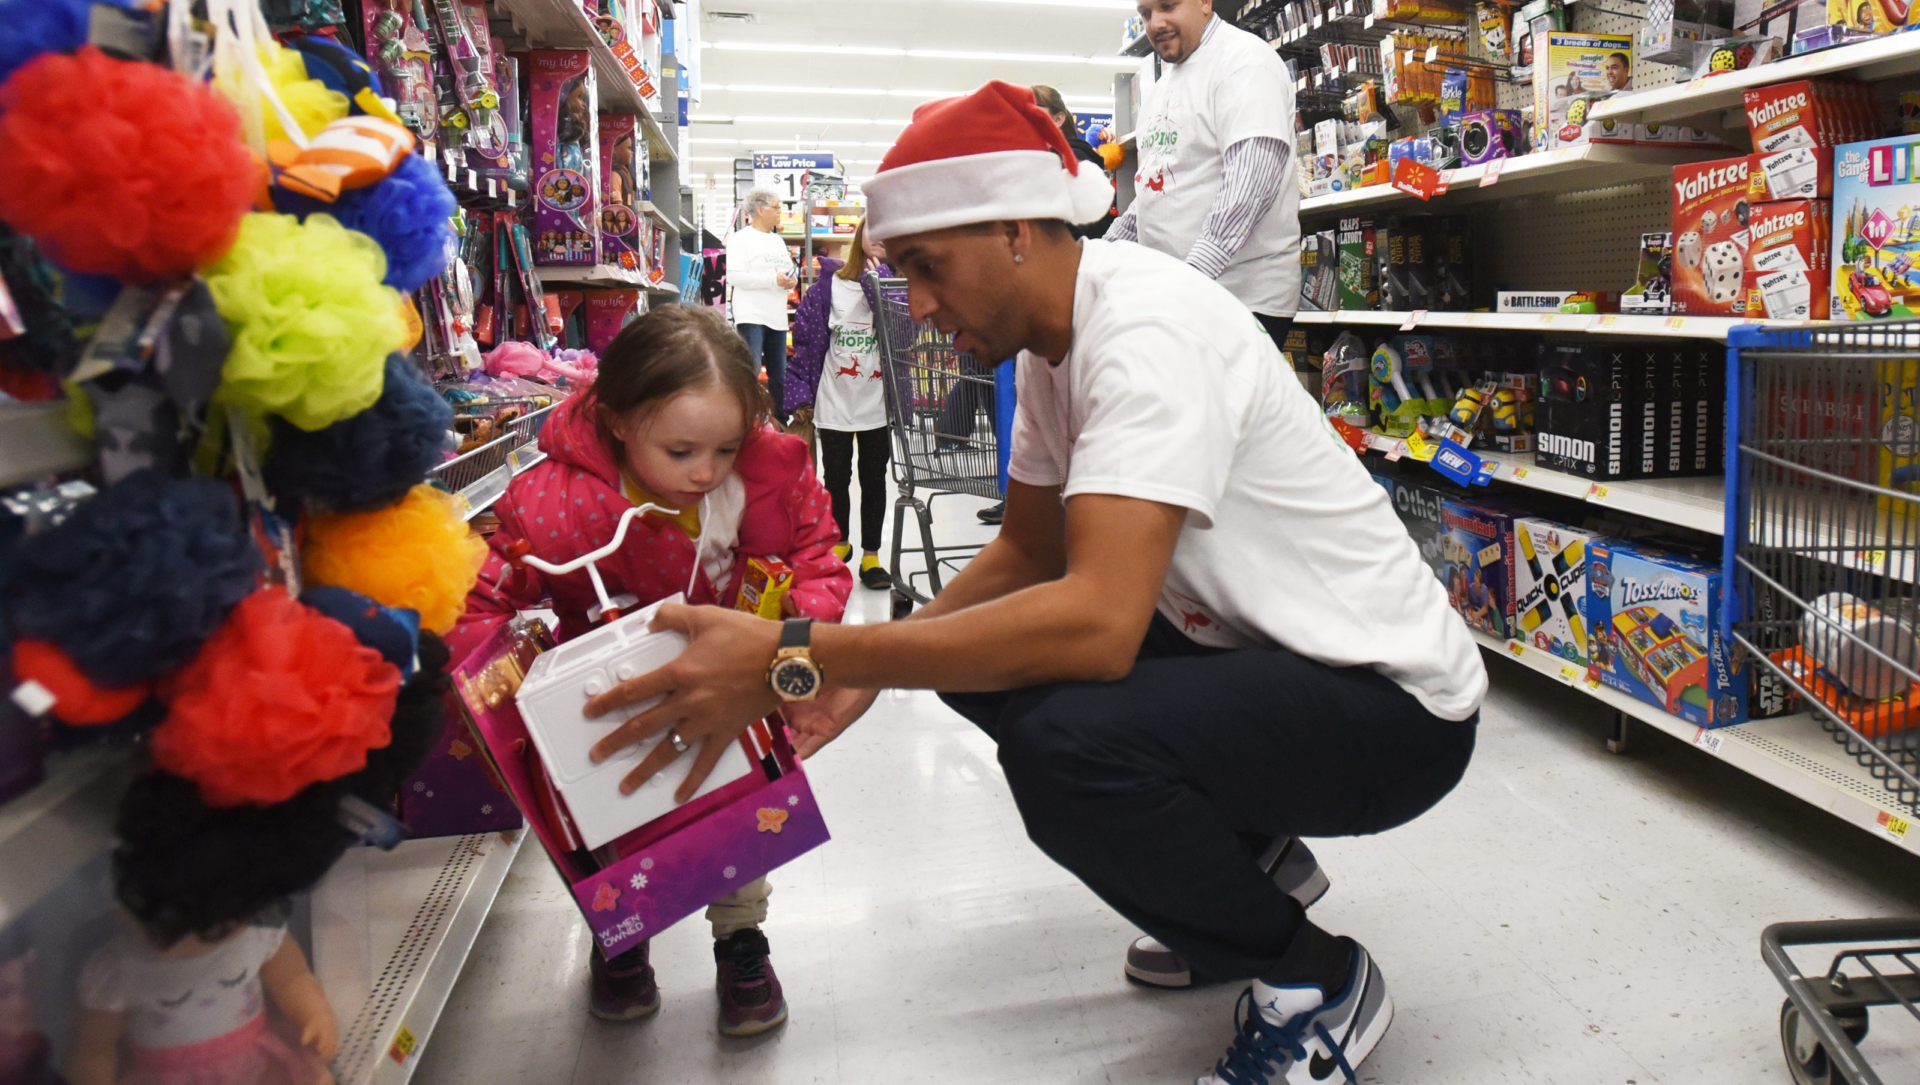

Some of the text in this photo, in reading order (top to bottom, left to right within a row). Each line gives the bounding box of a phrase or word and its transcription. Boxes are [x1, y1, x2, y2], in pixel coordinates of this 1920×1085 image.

[539, 55, 580, 68] my life
[1441, 82, 1463, 99] Farkle
[1747, 92, 1807, 128] Yahtzee
[1765, 133, 1790, 151] Yahtzee
[771, 158, 816, 168] Low Price
[1766, 153, 1793, 171] Yahtzee
[1845, 151, 1861, 163] the
[1838, 157, 1871, 178] Game
[1675, 161, 1748, 206] Yahtzee
[1859, 172, 1870, 184] of
[1397, 181, 1425, 197] Rollback
[1735, 183, 1748, 191] GAM
[1340, 217, 1360, 231] CRAPS
[1749, 211, 1805, 242] Yahtzee
[1339, 231, 1363, 245] LAYOUT
[1758, 251, 1782, 267] Yahtzee
[1762, 273, 1788, 290] Yahtzee
[1510, 296, 1561, 308] BATTLESHIP
[1440, 450, 1463, 469] NEW
[1396, 485, 1443, 524] Othel
[1441, 507, 1497, 539] Rummikub
[603, 922, 644, 947] OWNED
